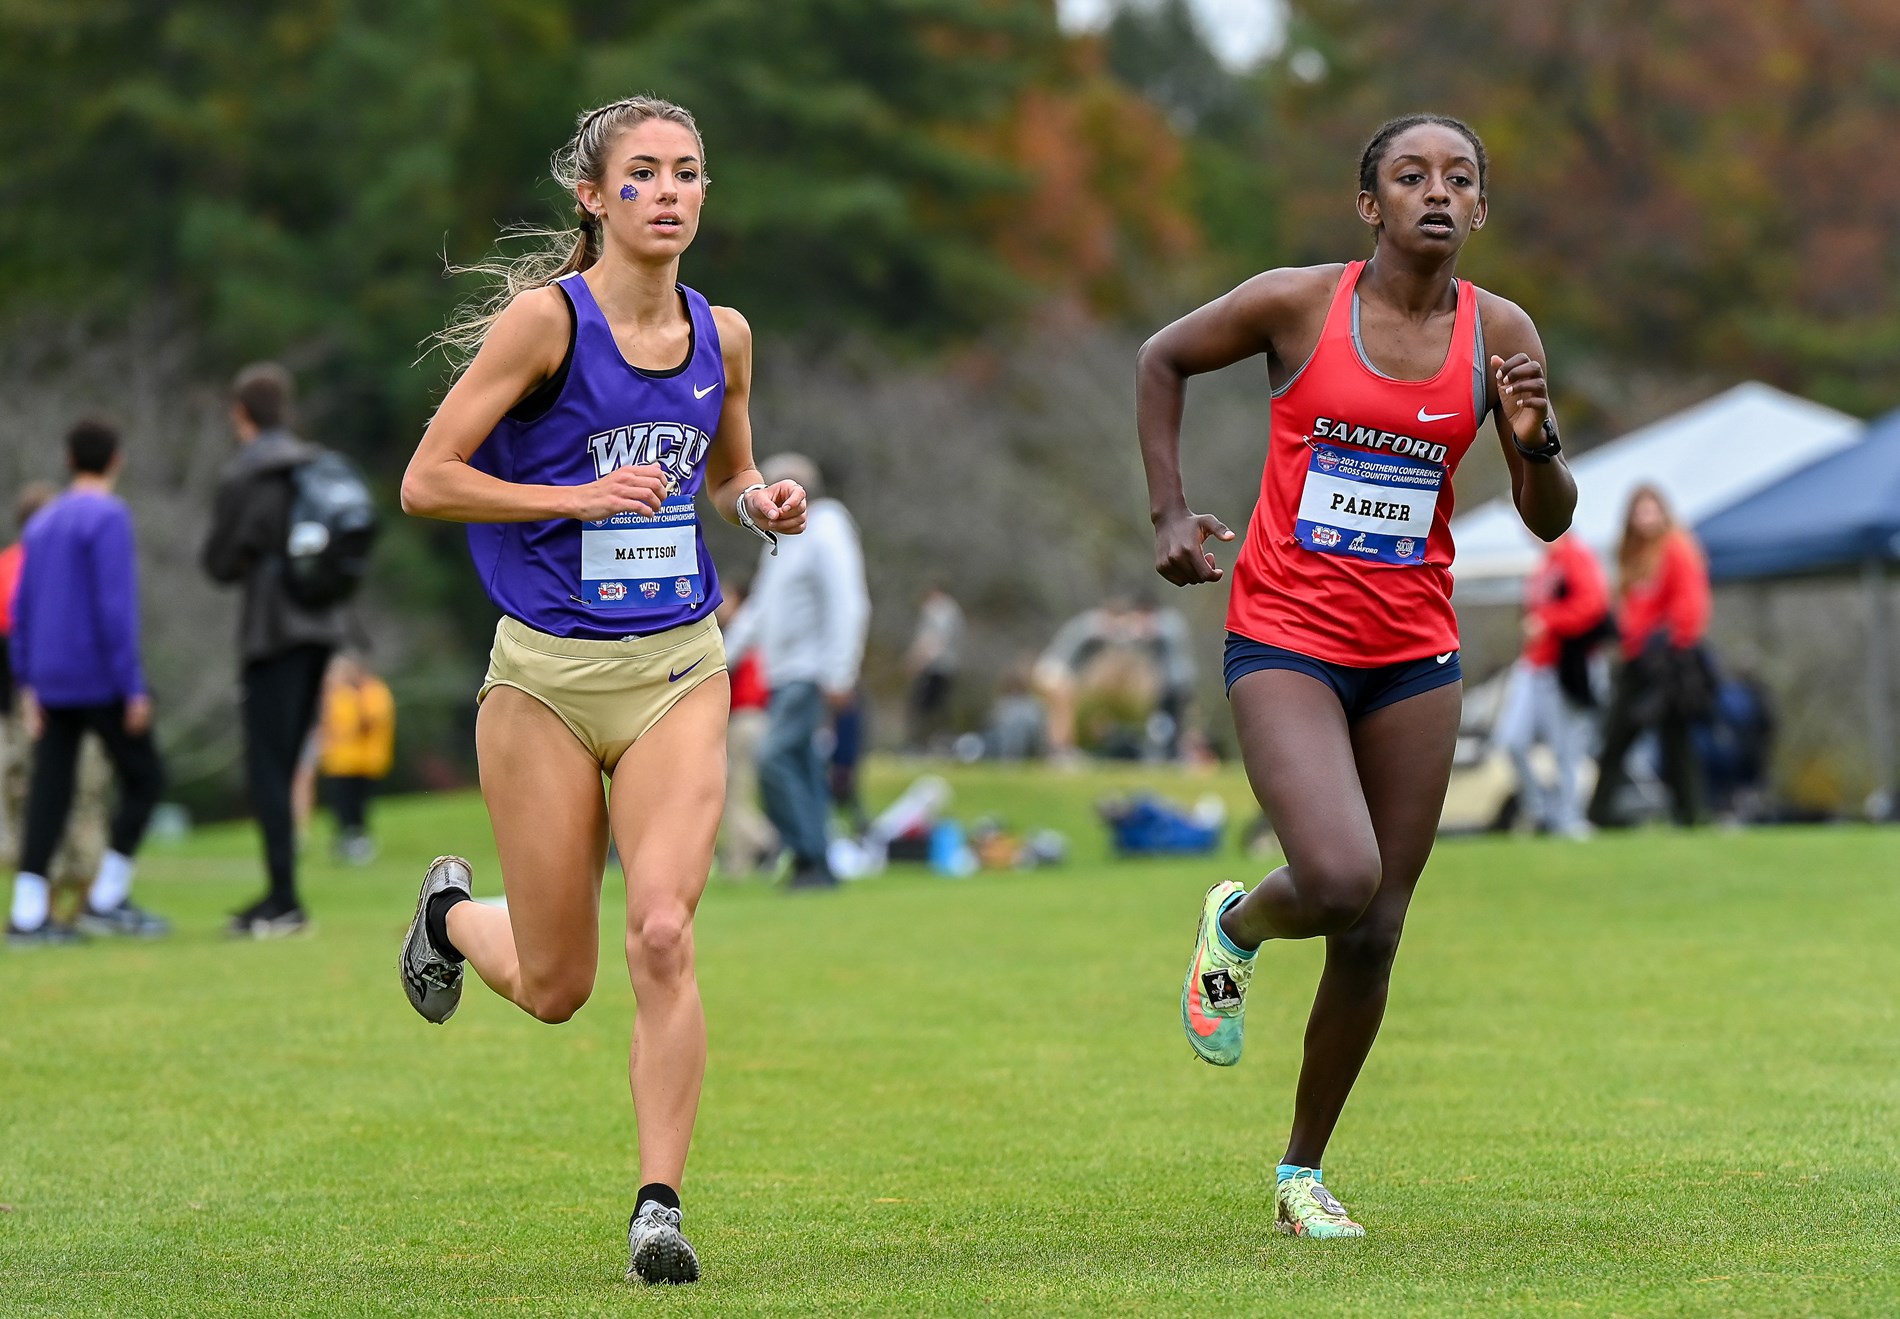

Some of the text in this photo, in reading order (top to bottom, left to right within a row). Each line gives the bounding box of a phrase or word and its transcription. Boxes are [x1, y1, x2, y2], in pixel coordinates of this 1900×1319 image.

[1313, 416, 1449, 463] SAMFORD
[587, 422, 710, 480] WCU
[1338, 465, 1440, 486] CROSS COUNTRY CHAMPIONSHIPS
[1340, 457, 1359, 467] 2021
[1359, 461, 1399, 474] SOUTHERN
[1399, 467, 1443, 479] CONFERENCE
[665, 504, 695, 514] CONFERENCE
[1330, 493, 1411, 521] PARKER
[610, 515, 631, 525] CROSS
[661, 513, 695, 522] CHAMPIONSHIPS
[615, 546, 677, 560] MATTISON
[1348, 545, 1379, 554] SAMFORD
[639, 582, 660, 592] WCU
